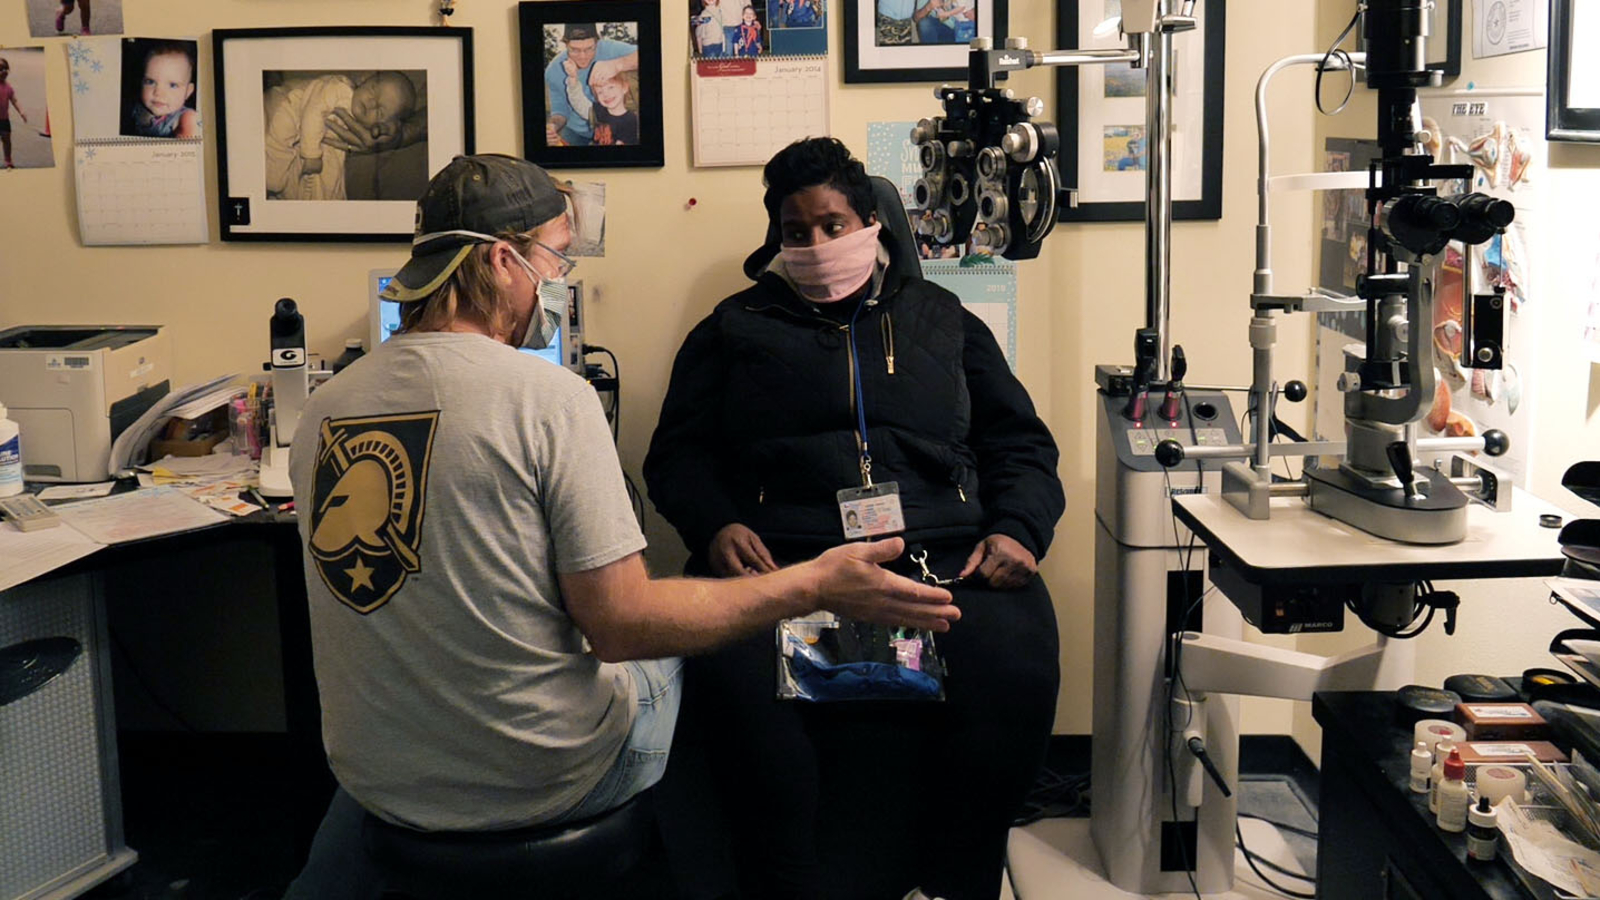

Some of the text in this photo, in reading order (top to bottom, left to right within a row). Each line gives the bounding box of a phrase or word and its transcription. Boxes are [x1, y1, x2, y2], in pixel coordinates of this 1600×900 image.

[775, 65, 802, 74] January
[1452, 103, 1485, 115] THE EYE
[151, 151, 177, 159] January
